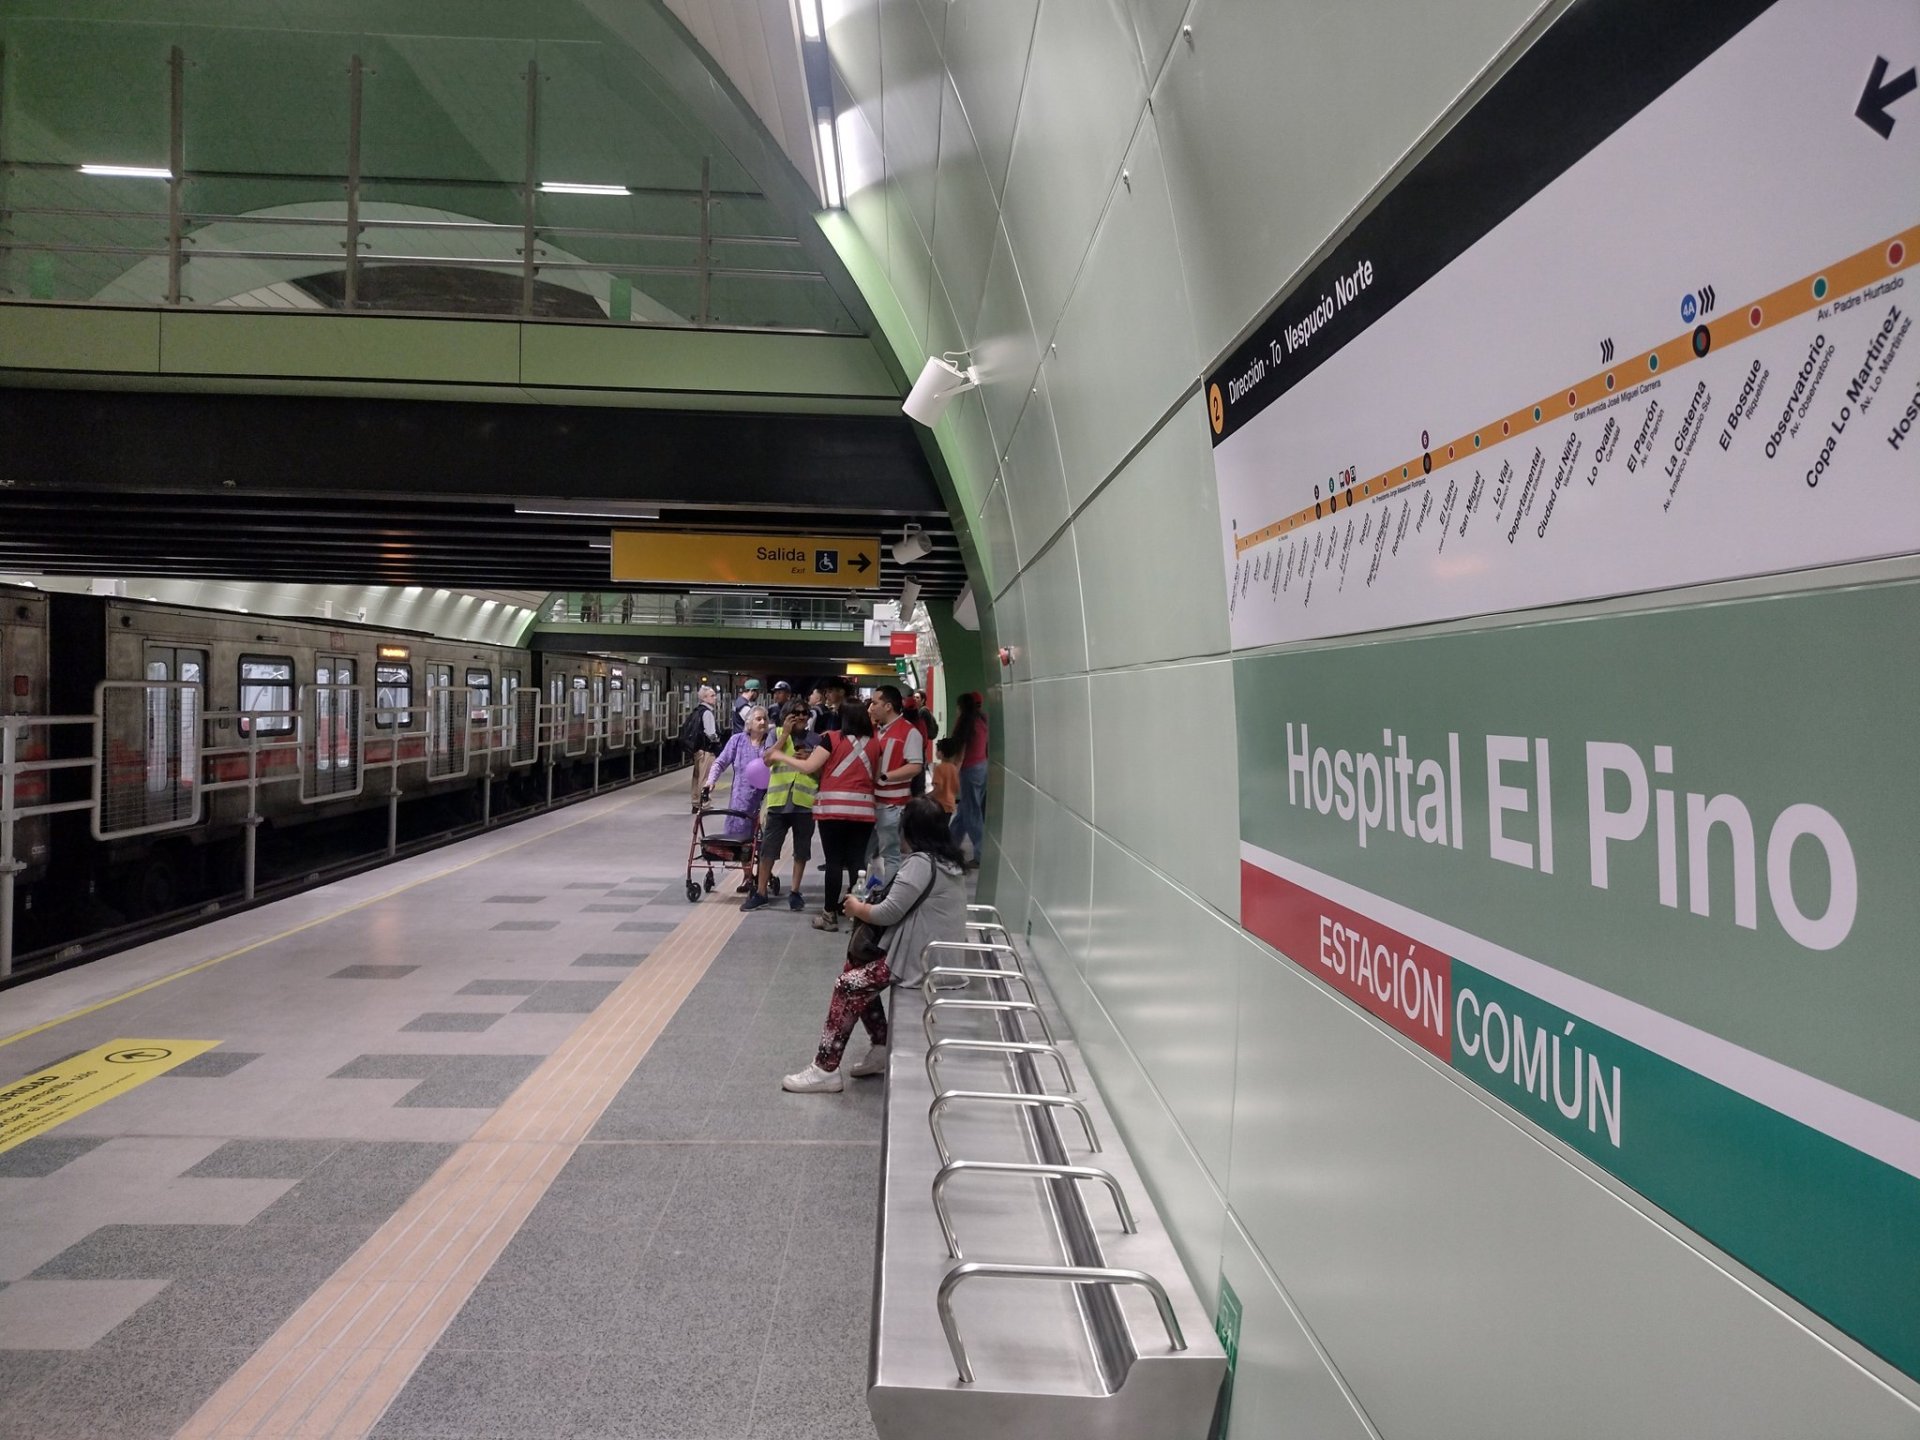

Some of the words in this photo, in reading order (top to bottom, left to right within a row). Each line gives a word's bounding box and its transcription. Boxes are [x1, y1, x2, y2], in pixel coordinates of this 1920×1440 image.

[1683, 300, 1695, 316] 4A
[1818, 309, 1832, 322] Av.
[1834, 293, 1861, 314] Padre
[1863, 276, 1904, 302] Hurtado
[1213, 396, 1221, 422] 2
[1229, 358, 1266, 404] Dirección
[1270, 340, 1282, 367] To
[1284, 295, 1334, 354] Vespucio
[1335, 260, 1373, 310] Norte
[1574, 410, 1586, 421] Gran
[1586, 402, 1606, 416] Avenida
[1608, 396, 1620, 408] José
[1620, 389, 1638, 402] Miguel
[1640, 380, 1661, 394] Carrera
[1650, 409, 1664, 440] Parrón
[1719, 429, 1732, 452] El
[1728, 359, 1762, 430] Bosque
[1745, 369, 1770, 420] Riquelme
[1765, 334, 1826, 458] Observatorio
[1790, 422, 1800, 438] Av.
[1798, 344, 1836, 418] Observatorio
[1806, 436, 1837, 488] Copa
[1832, 406, 1850, 434] Lo
[1846, 304, 1902, 404] Martínez
[1860, 395, 1874, 415] Av.
[1870, 375, 1882, 393] Lo
[1888, 382, 1920, 451] Hosp
[1587, 466, 1598, 486] Lo
[1596, 417, 1616, 463] Ovalle
[1627, 454, 1638, 474] El
[1634, 400, 1658, 455] Parrón
[1664, 454, 1678, 477] La
[1674, 380, 1706, 452] Cisterna
[1669, 458, 1687, 497] Américo
[1684, 414, 1704, 456] Vespucio
[1702, 392, 1712, 412] Sur
[1416, 490, 1430, 534] Franklin
[1440, 511, 1446, 525] El
[1443, 480, 1454, 512] Llano
[1460, 514, 1469, 538] San
[1466, 470, 1481, 513] Miguel
[1493, 488, 1502, 504] Lo
[1498, 460, 1510, 485] Vial
[1508, 446, 1542, 544] Departamental
[1538, 489, 1556, 538] Ciudad
[1555, 465, 1564, 490] del
[1562, 432, 1576, 466] Niño
[756, 547, 806, 562] Salida
[1286, 722, 1463, 850] Hospital
[1486, 734, 1553, 874] El
[1586, 741, 1858, 951] Pino
[1319, 914, 1444, 1036] ESTACIÓN
[1456, 988, 1621, 1148] COMÚN
